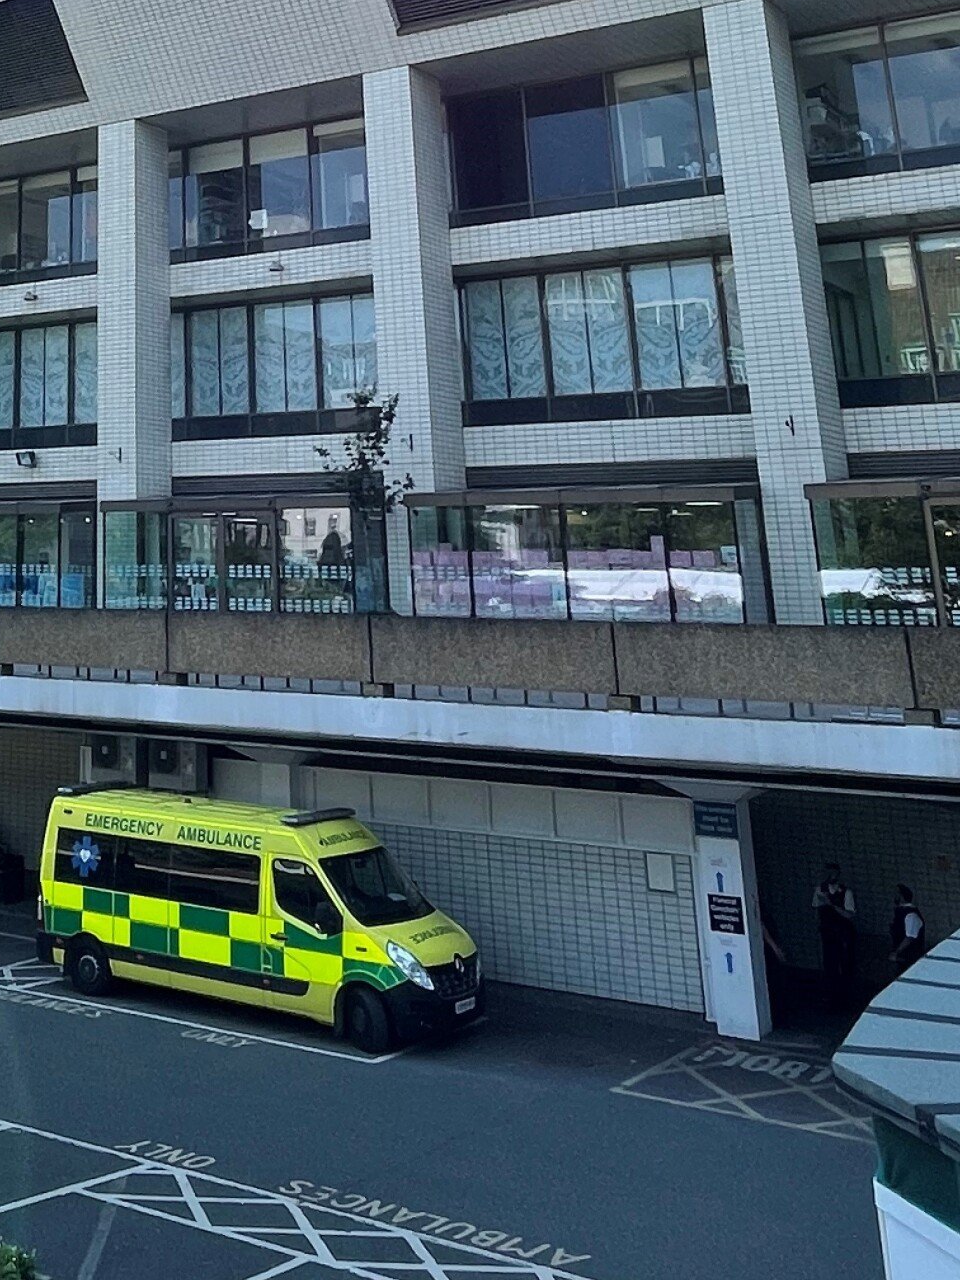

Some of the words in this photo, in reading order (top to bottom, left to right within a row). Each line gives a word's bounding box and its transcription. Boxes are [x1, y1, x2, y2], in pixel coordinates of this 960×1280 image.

[85, 813, 164, 837] EMERGENCY
[176, 825, 262, 851] AMBULANCE
[180, 1030, 256, 1049] ONLY
[115, 1140, 216, 1170] ONLY
[279, 1179, 592, 1268] AMBULANCES
